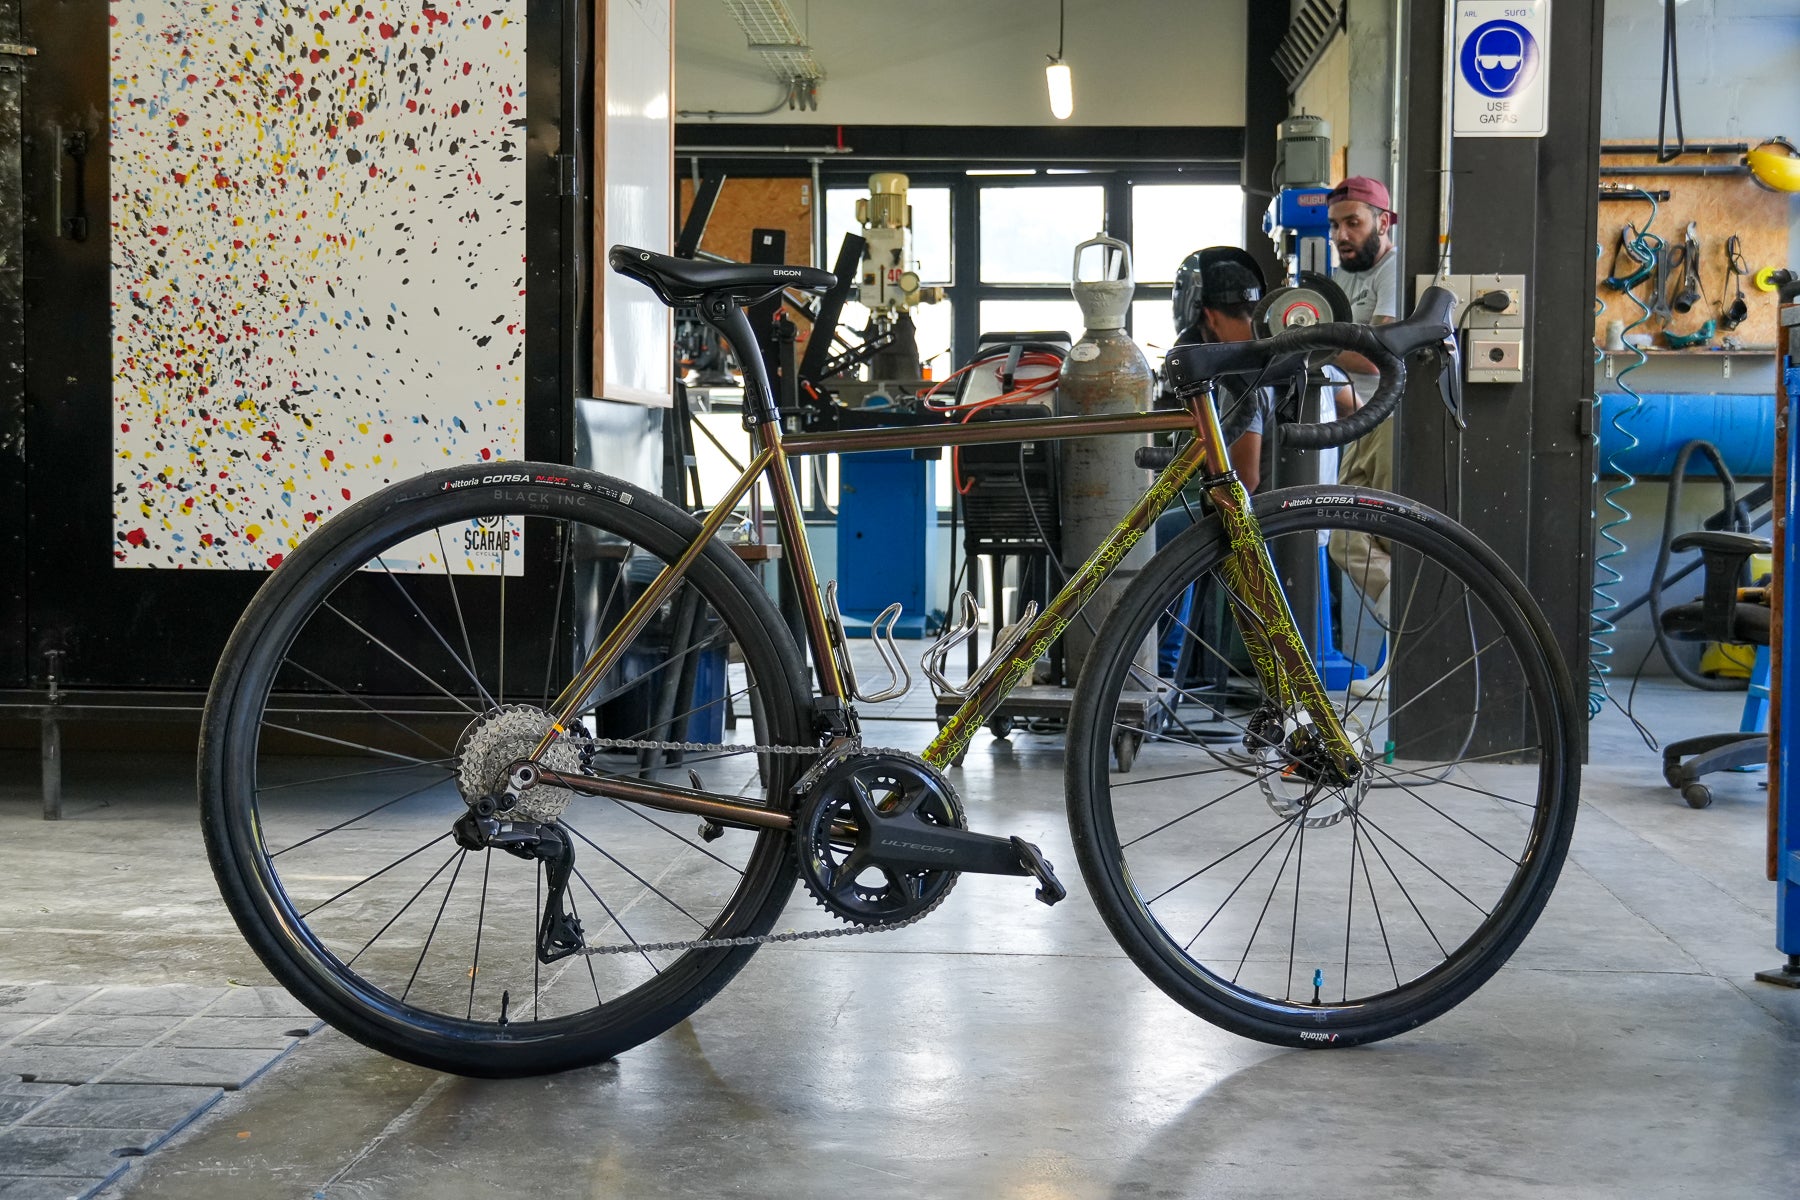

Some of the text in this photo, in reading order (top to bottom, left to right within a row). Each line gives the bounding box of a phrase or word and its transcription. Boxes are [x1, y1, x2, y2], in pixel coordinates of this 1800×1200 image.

[1504, 9, 1526, 17] sura
[1486, 102, 1510, 112] USE
[1479, 114, 1518, 124] GAFAS
[773, 269, 802, 277] ERGON
[449, 477, 479, 489] vittoria
[482, 474, 530, 484] CORSA
[494, 489, 586, 506] BLACK INC
[1288, 497, 1313, 508] vittoria
[1315, 496, 1354, 504] CORSA
[1317, 509, 1359, 520] BLACK
[1365, 513, 1387, 523] INC
[464, 530, 510, 551] SCARAB
[881, 839, 955, 855] ULTEGRA
[1300, 1031, 1330, 1041] vittoria
